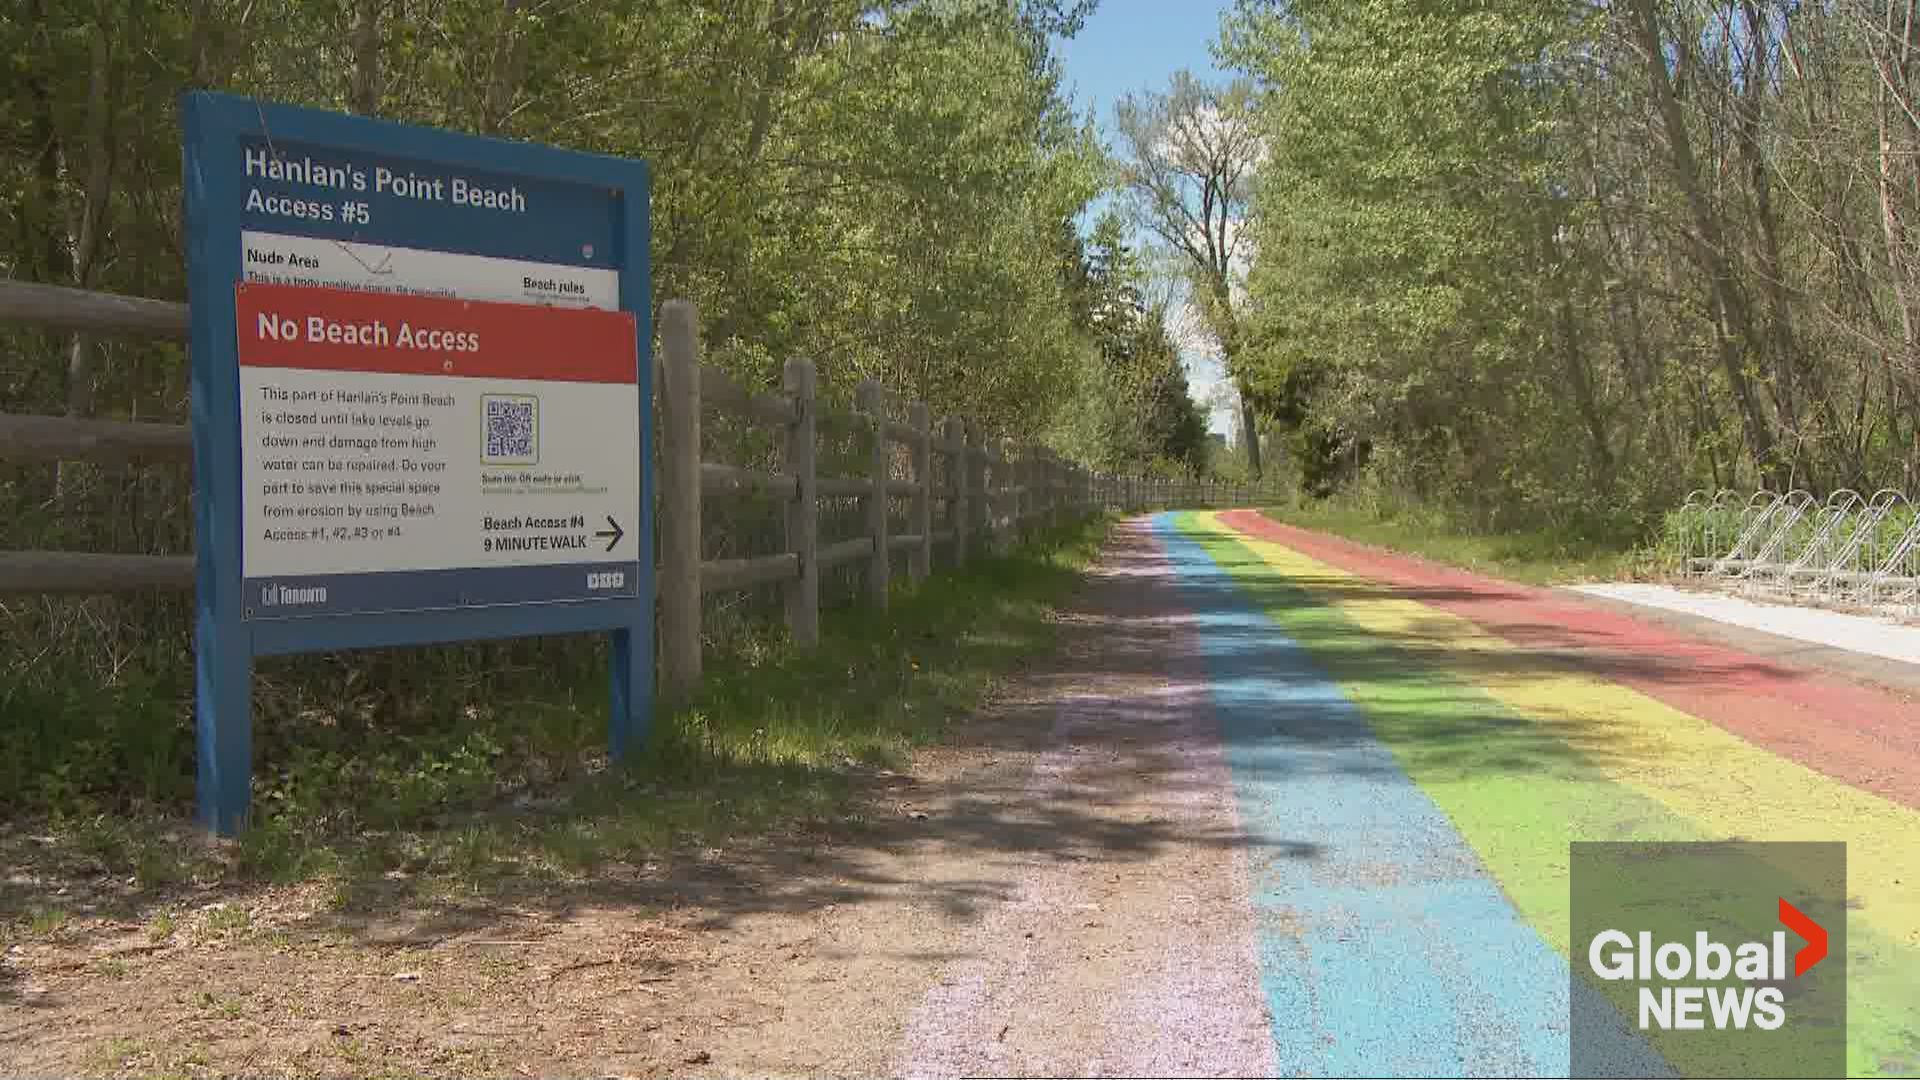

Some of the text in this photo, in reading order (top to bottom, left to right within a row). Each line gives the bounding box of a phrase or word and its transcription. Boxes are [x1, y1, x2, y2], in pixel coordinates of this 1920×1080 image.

[245, 148, 526, 213] Hanlan's Point Beach
[245, 188, 370, 225] Access #5
[246, 248, 320, 269] Nude Area
[523, 277, 585, 294] Beach rules
[257, 312, 479, 353] No Beach Access
[261, 387, 455, 407] This part of Hanlan's Point Beach
[262, 411, 430, 429] is closed until lake levels go
[262, 435, 437, 452] down and damage from high
[262, 458, 447, 473] water can be repaired. Do your
[263, 481, 441, 496] part to save this special space
[263, 503, 434, 519] from erosion by using Beach
[484, 515, 585, 530] Beach Access #4
[263, 528, 307, 542] Access
[310, 527, 330, 541] #1,
[332, 526, 351, 540] #2,
[354, 526, 369, 539] #3
[371, 528, 385, 540] or
[484, 535, 587, 552] 9 MINUTE WALK
